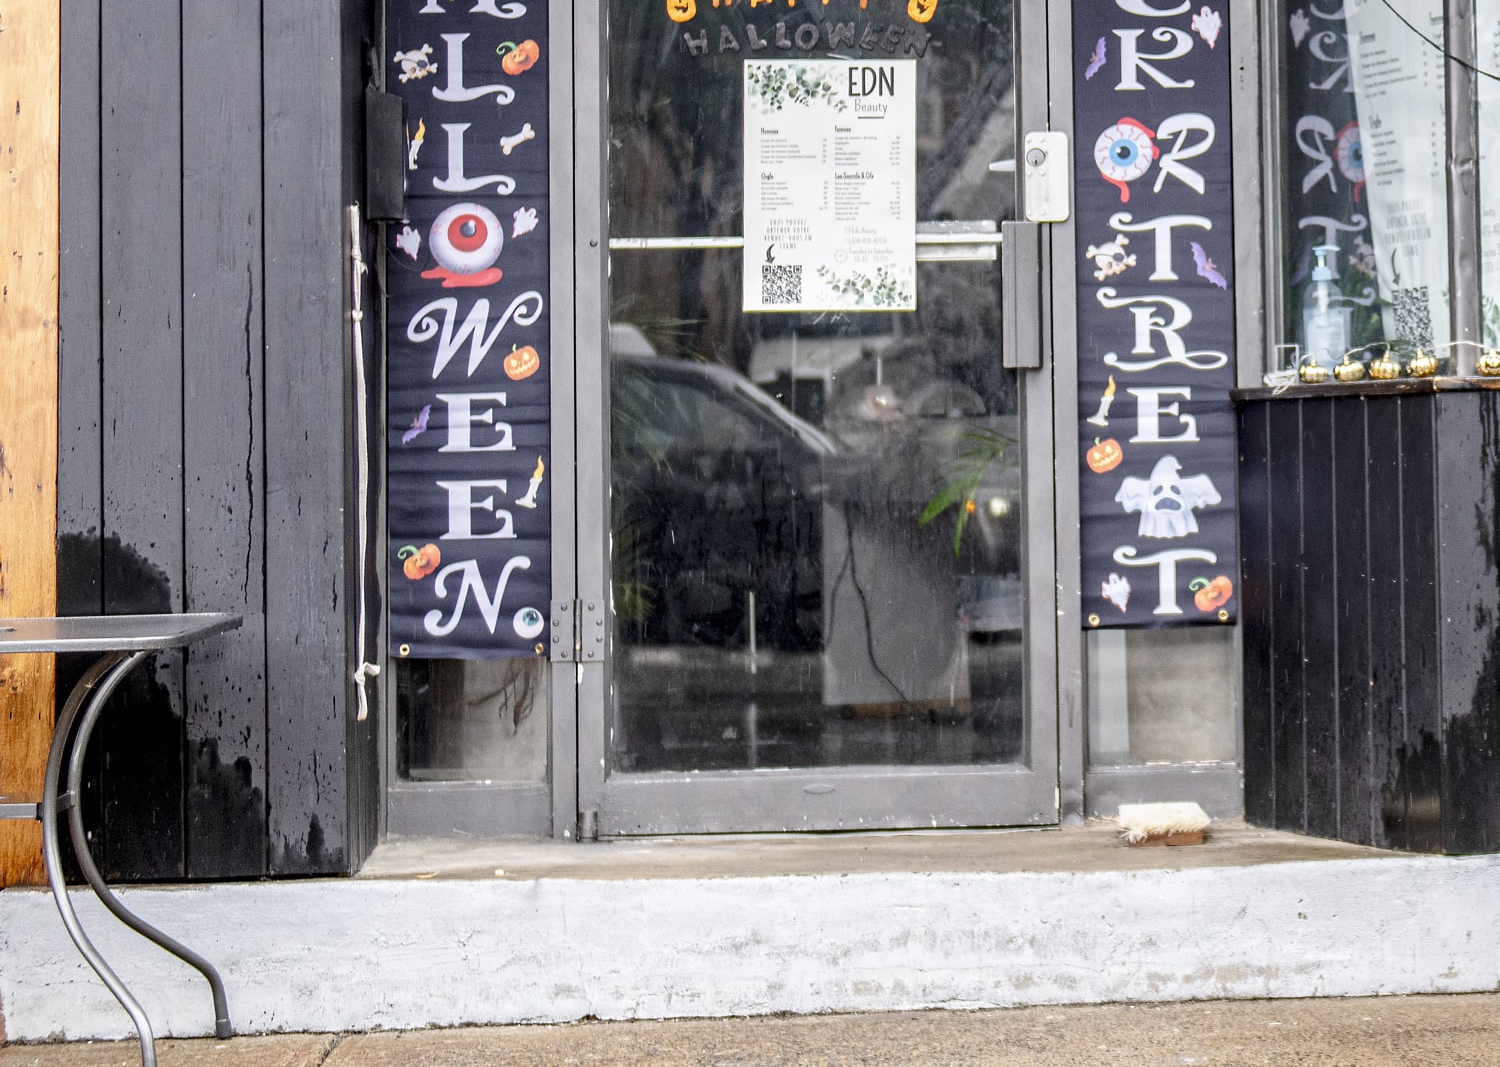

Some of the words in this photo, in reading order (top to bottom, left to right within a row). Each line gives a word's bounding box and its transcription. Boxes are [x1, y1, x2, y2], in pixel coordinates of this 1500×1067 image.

[683, 20, 932, 58] HALLOWEEN
[847, 66, 895, 98] EDN
[853, 98, 889, 115] Beauty
